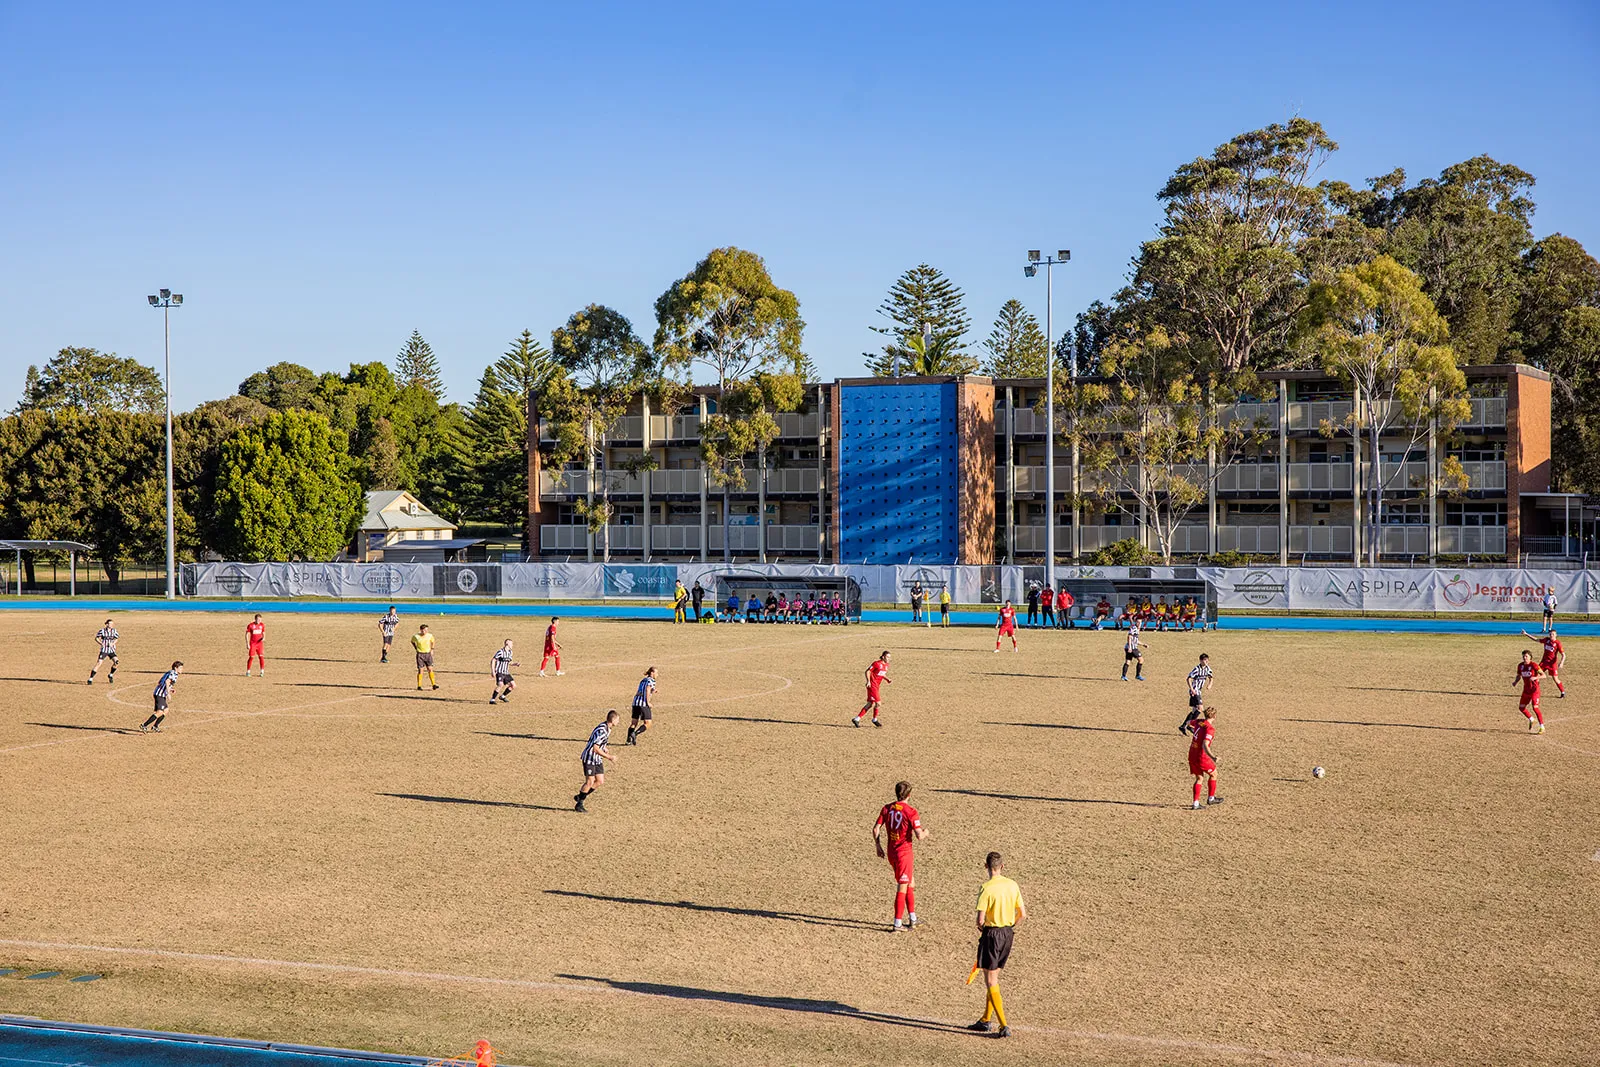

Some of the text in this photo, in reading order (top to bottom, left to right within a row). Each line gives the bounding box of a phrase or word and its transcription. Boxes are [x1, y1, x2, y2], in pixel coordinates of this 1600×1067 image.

[284, 572, 333, 583] ASPIRA
[1345, 580, 1420, 594] ASPIRA
[1473, 583, 1545, 596] Jesmond
[889, 810, 903, 829] 19
